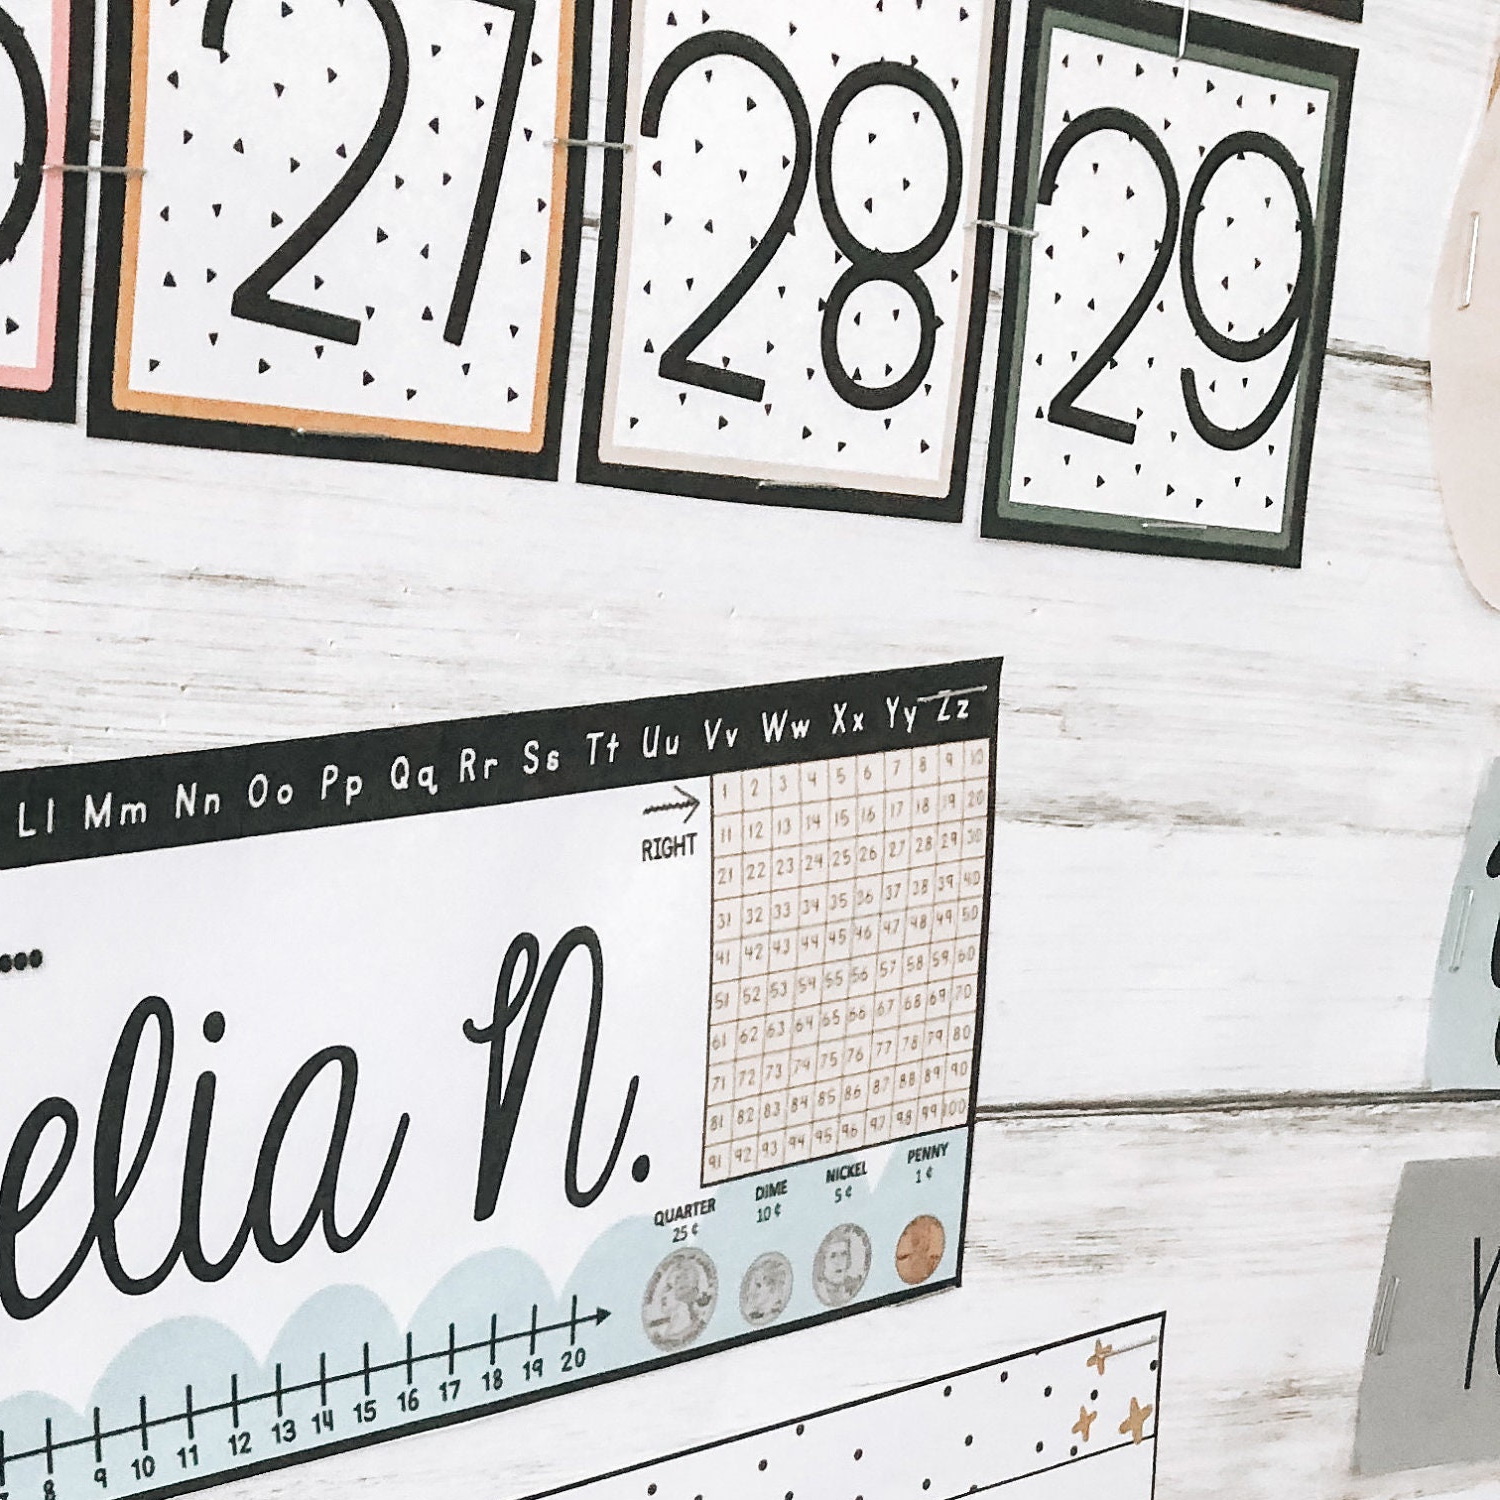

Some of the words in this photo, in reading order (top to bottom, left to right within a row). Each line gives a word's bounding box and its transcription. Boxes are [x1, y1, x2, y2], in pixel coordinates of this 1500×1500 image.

[201, 0, 537, 347] 27
[640, 29, 964, 411] 28
[1037, 106, 1317, 452] 29
[84, 791, 147, 831] Mm
[175, 782, 220, 819] Nn
[248, 773, 294, 809] Oo
[320, 764, 363, 806] Pp
[390, 755, 438, 796] Qq
[459, 747, 499, 783] Rr
[522, 739, 560, 775] Ss
[586, 731, 620, 766] Tt
[642, 724, 680, 759] Uu
[703, 717, 739, 751] Vv
[761, 709, 811, 743] Ww
[831, 702, 864, 735] Xx
[886, 695, 918, 734] Yy
[642, 832, 699, 862] RIGHT
[755, 1179, 788, 1202] DIME
[825, 1161, 868, 1183] NICKEL
[907, 1141, 949, 1165] PENNY
[654, 1197, 717, 1227] QUARTER
[93, 1467, 108, 1489] 9
[130, 1455, 156, 1481] 10
[176, 1444, 199, 1468] 11
[228, 1431, 252, 1457] 12
[271, 1419, 297, 1444] 13
[311, 1409, 334, 1434] 14
[353, 1399, 377, 1423] 15
[397, 1387, 420, 1412] 16
[439, 1379, 461, 1402] 17
[481, 1368, 504, 1392] 18
[522, 1357, 544, 1381] 19
[561, 1347, 586, 1373] 20
